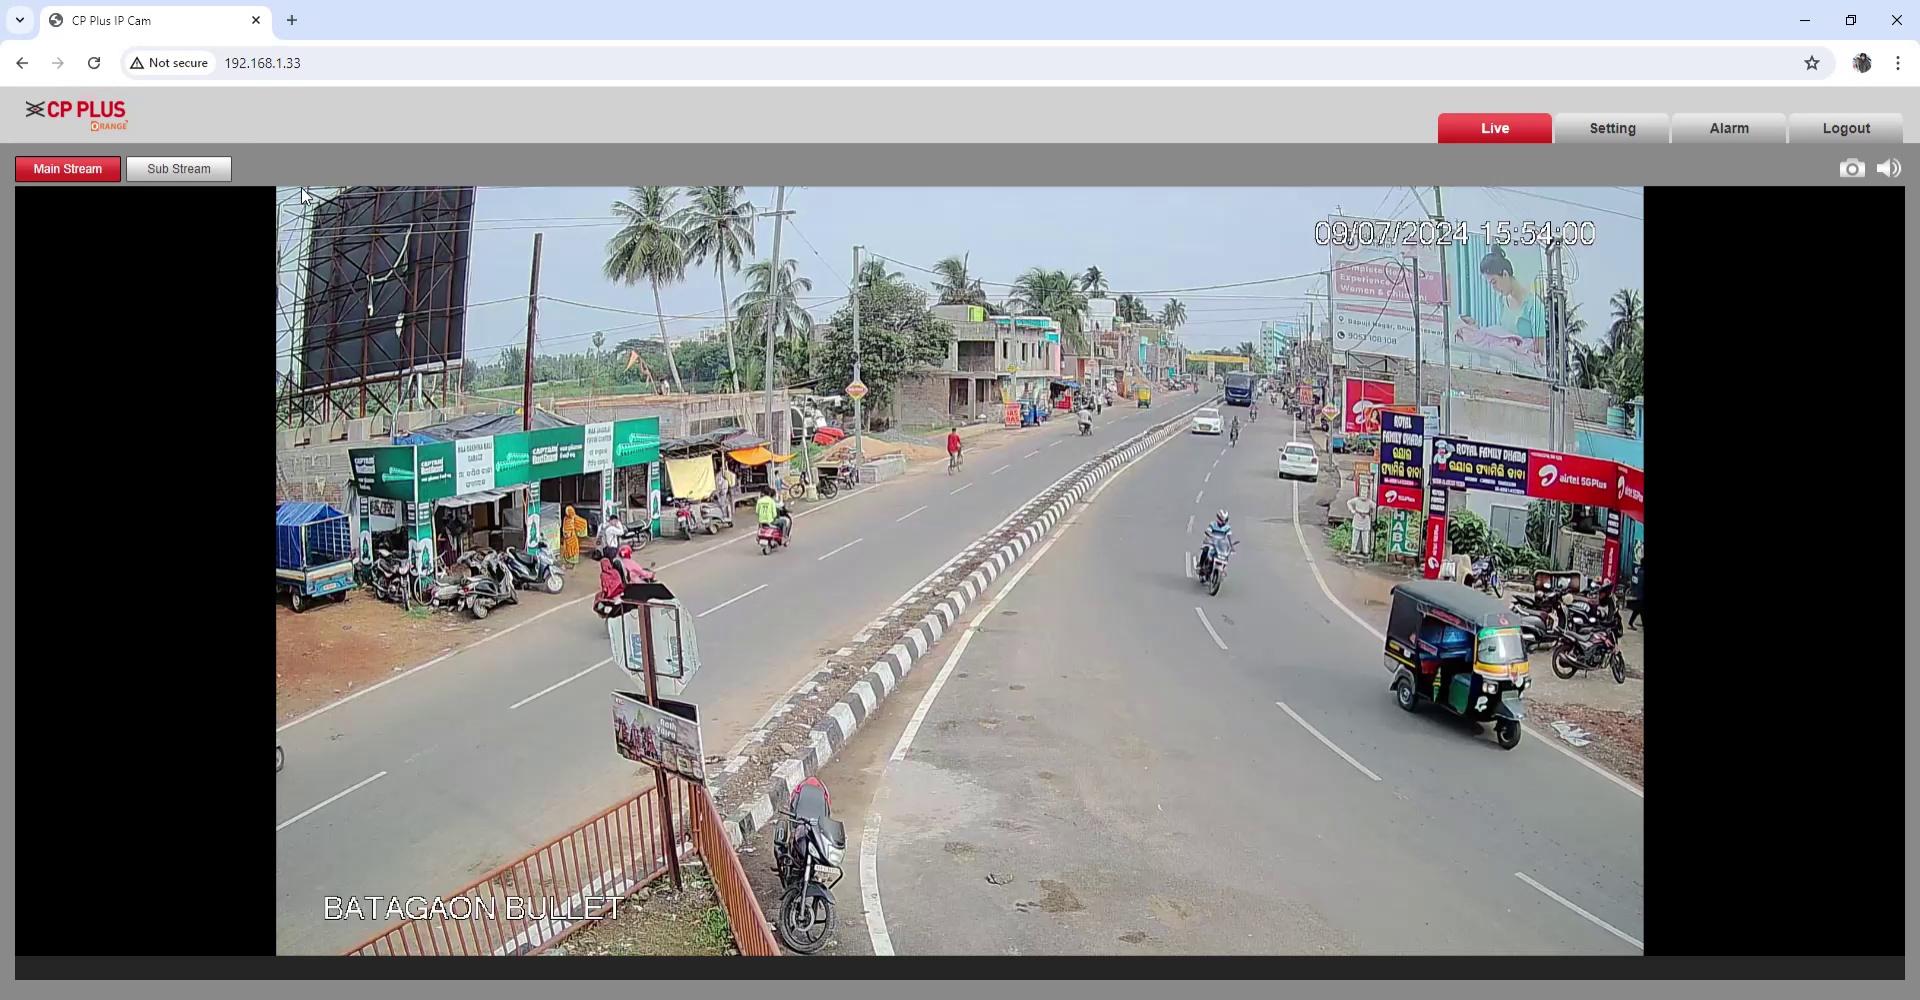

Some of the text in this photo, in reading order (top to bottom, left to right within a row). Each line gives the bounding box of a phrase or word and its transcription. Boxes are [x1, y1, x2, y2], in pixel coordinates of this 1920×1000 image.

[72, 15, 151, 26] CP Plus IP Cam
[149, 57, 209, 69] Not secure
[224, 57, 301, 69] 192.168.1.33
[47, 100, 126, 118] CP PLUS
[90, 120, 128, 132] ORANGE
[1481, 122, 1511, 135] Live
[1590, 122, 1636, 138] Setting
[1709, 122, 1750, 135] Alarm
[1823, 122, 1871, 138] Logout
[33, 163, 103, 175] Main Stream
[147, 163, 211, 175] Sub Stream
[1340, 284, 1375, 295] Women
[1393, 414, 1412, 429] ROYAL
[1382, 430, 1402, 445] FAMILY
[1456, 443, 1478, 457] ROYAL
[1479, 446, 1502, 460] FAMILY
[1559, 473, 1607, 489] airtel 5GPlus
